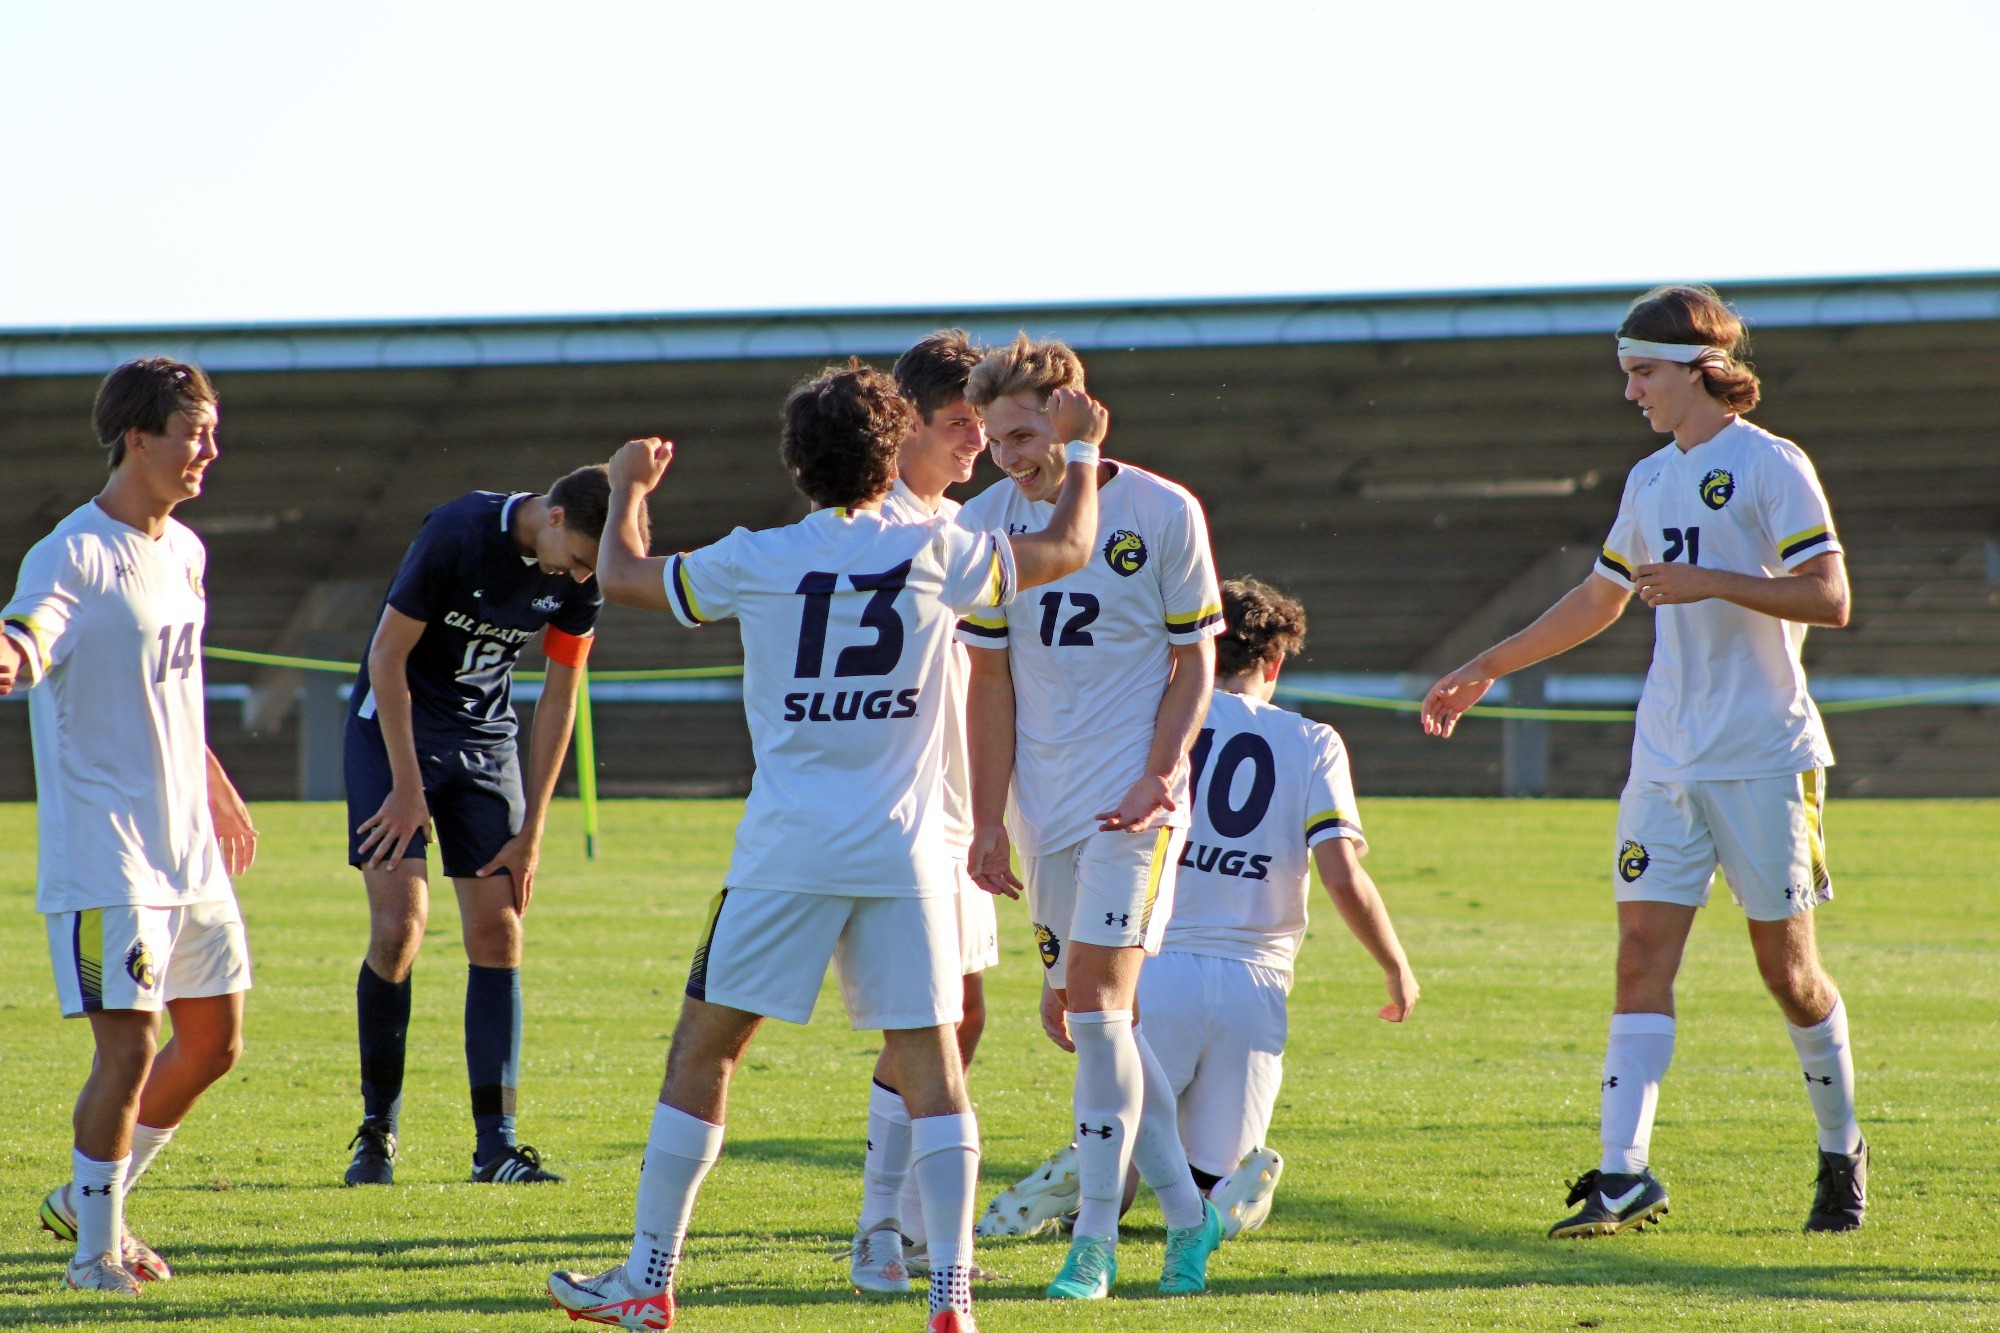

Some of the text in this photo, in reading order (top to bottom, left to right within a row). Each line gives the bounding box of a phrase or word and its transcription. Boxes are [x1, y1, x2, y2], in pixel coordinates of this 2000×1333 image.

[1662, 526, 1700, 566] 21
[444, 611, 475, 632] CAL
[793, 558, 913, 679] 13
[1039, 591, 1100, 647] 12
[156, 621, 195, 683] 14
[455, 639, 507, 674] 12
[783, 687, 920, 722] SLUGS
[1189, 727, 1276, 839] 10
[1178, 840, 1273, 880] LUGS
